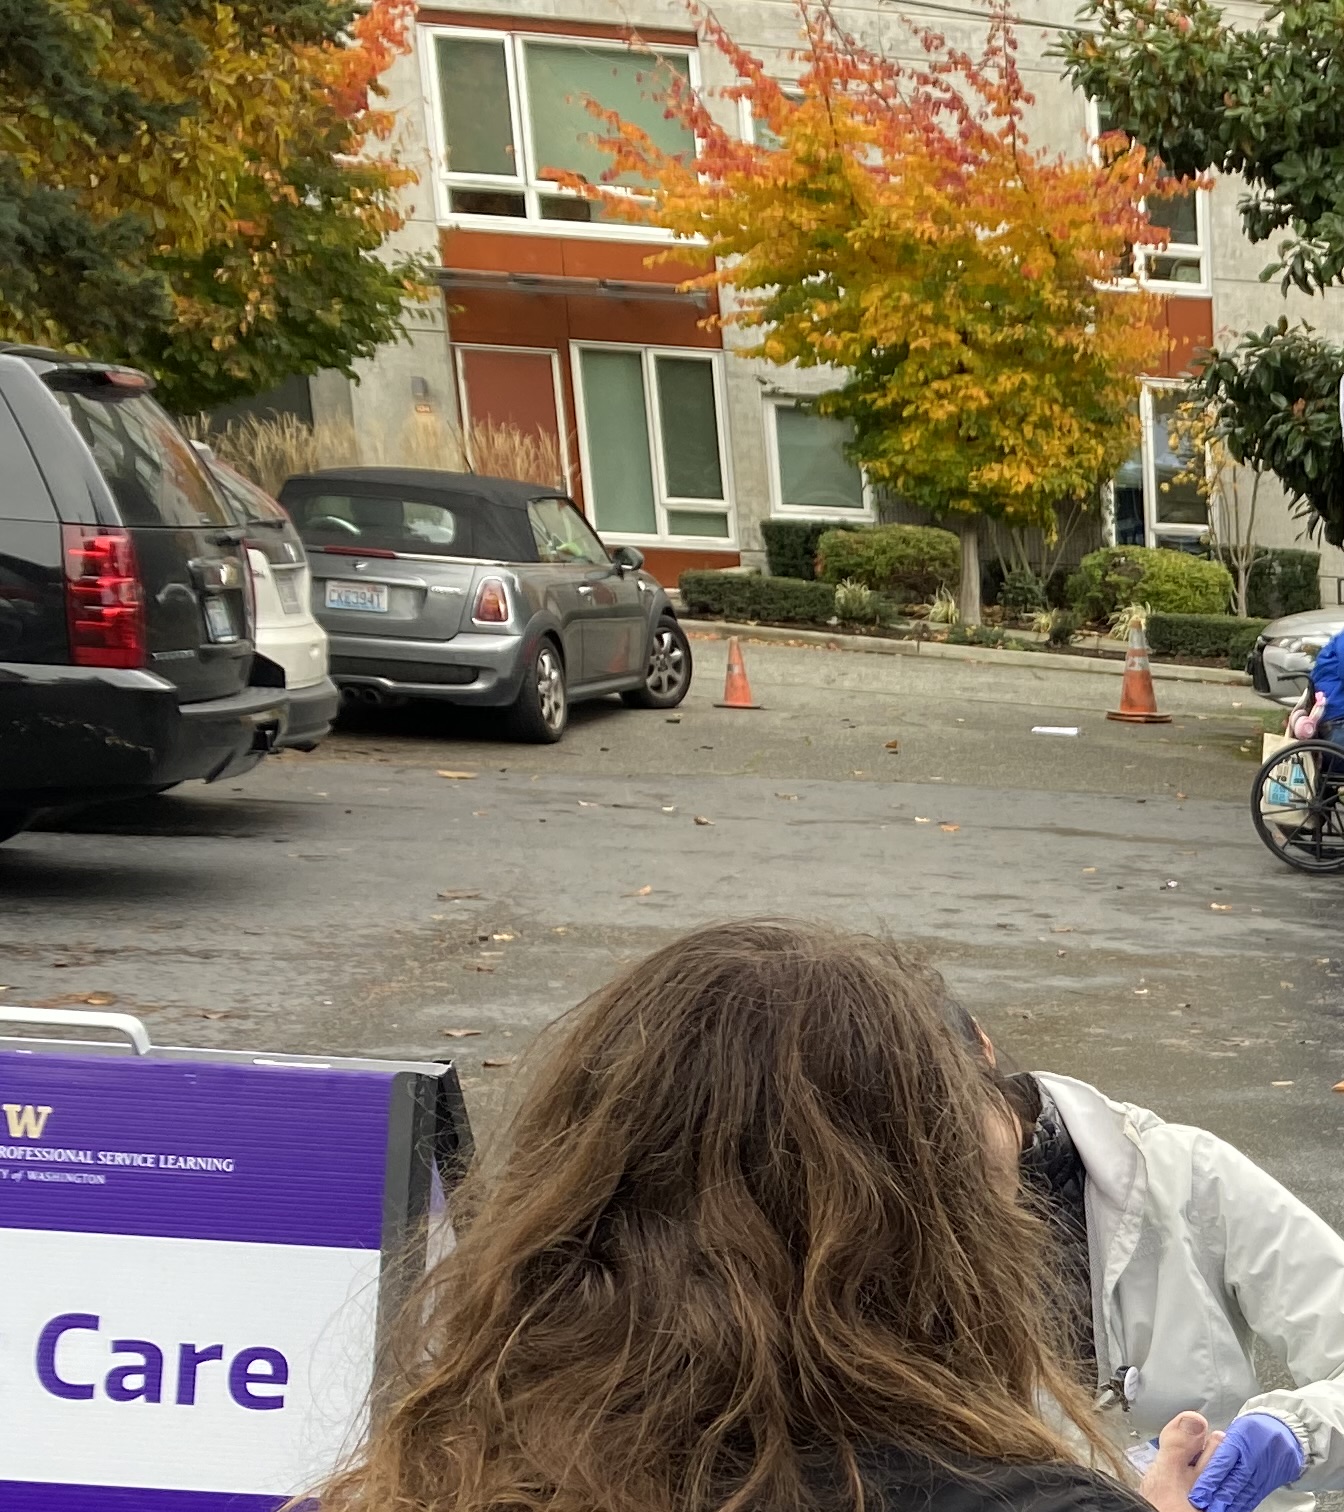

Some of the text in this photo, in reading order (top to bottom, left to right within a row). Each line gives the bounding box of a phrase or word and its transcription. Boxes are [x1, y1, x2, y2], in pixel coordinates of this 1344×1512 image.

[2, 1104, 54, 1139] W
[97, 1151, 156, 1168] SERVICE
[159, 1155, 235, 1172] LEARNING
[27, 1171, 106, 1185] WASHINGTON
[35, 1311, 290, 1411] Care
